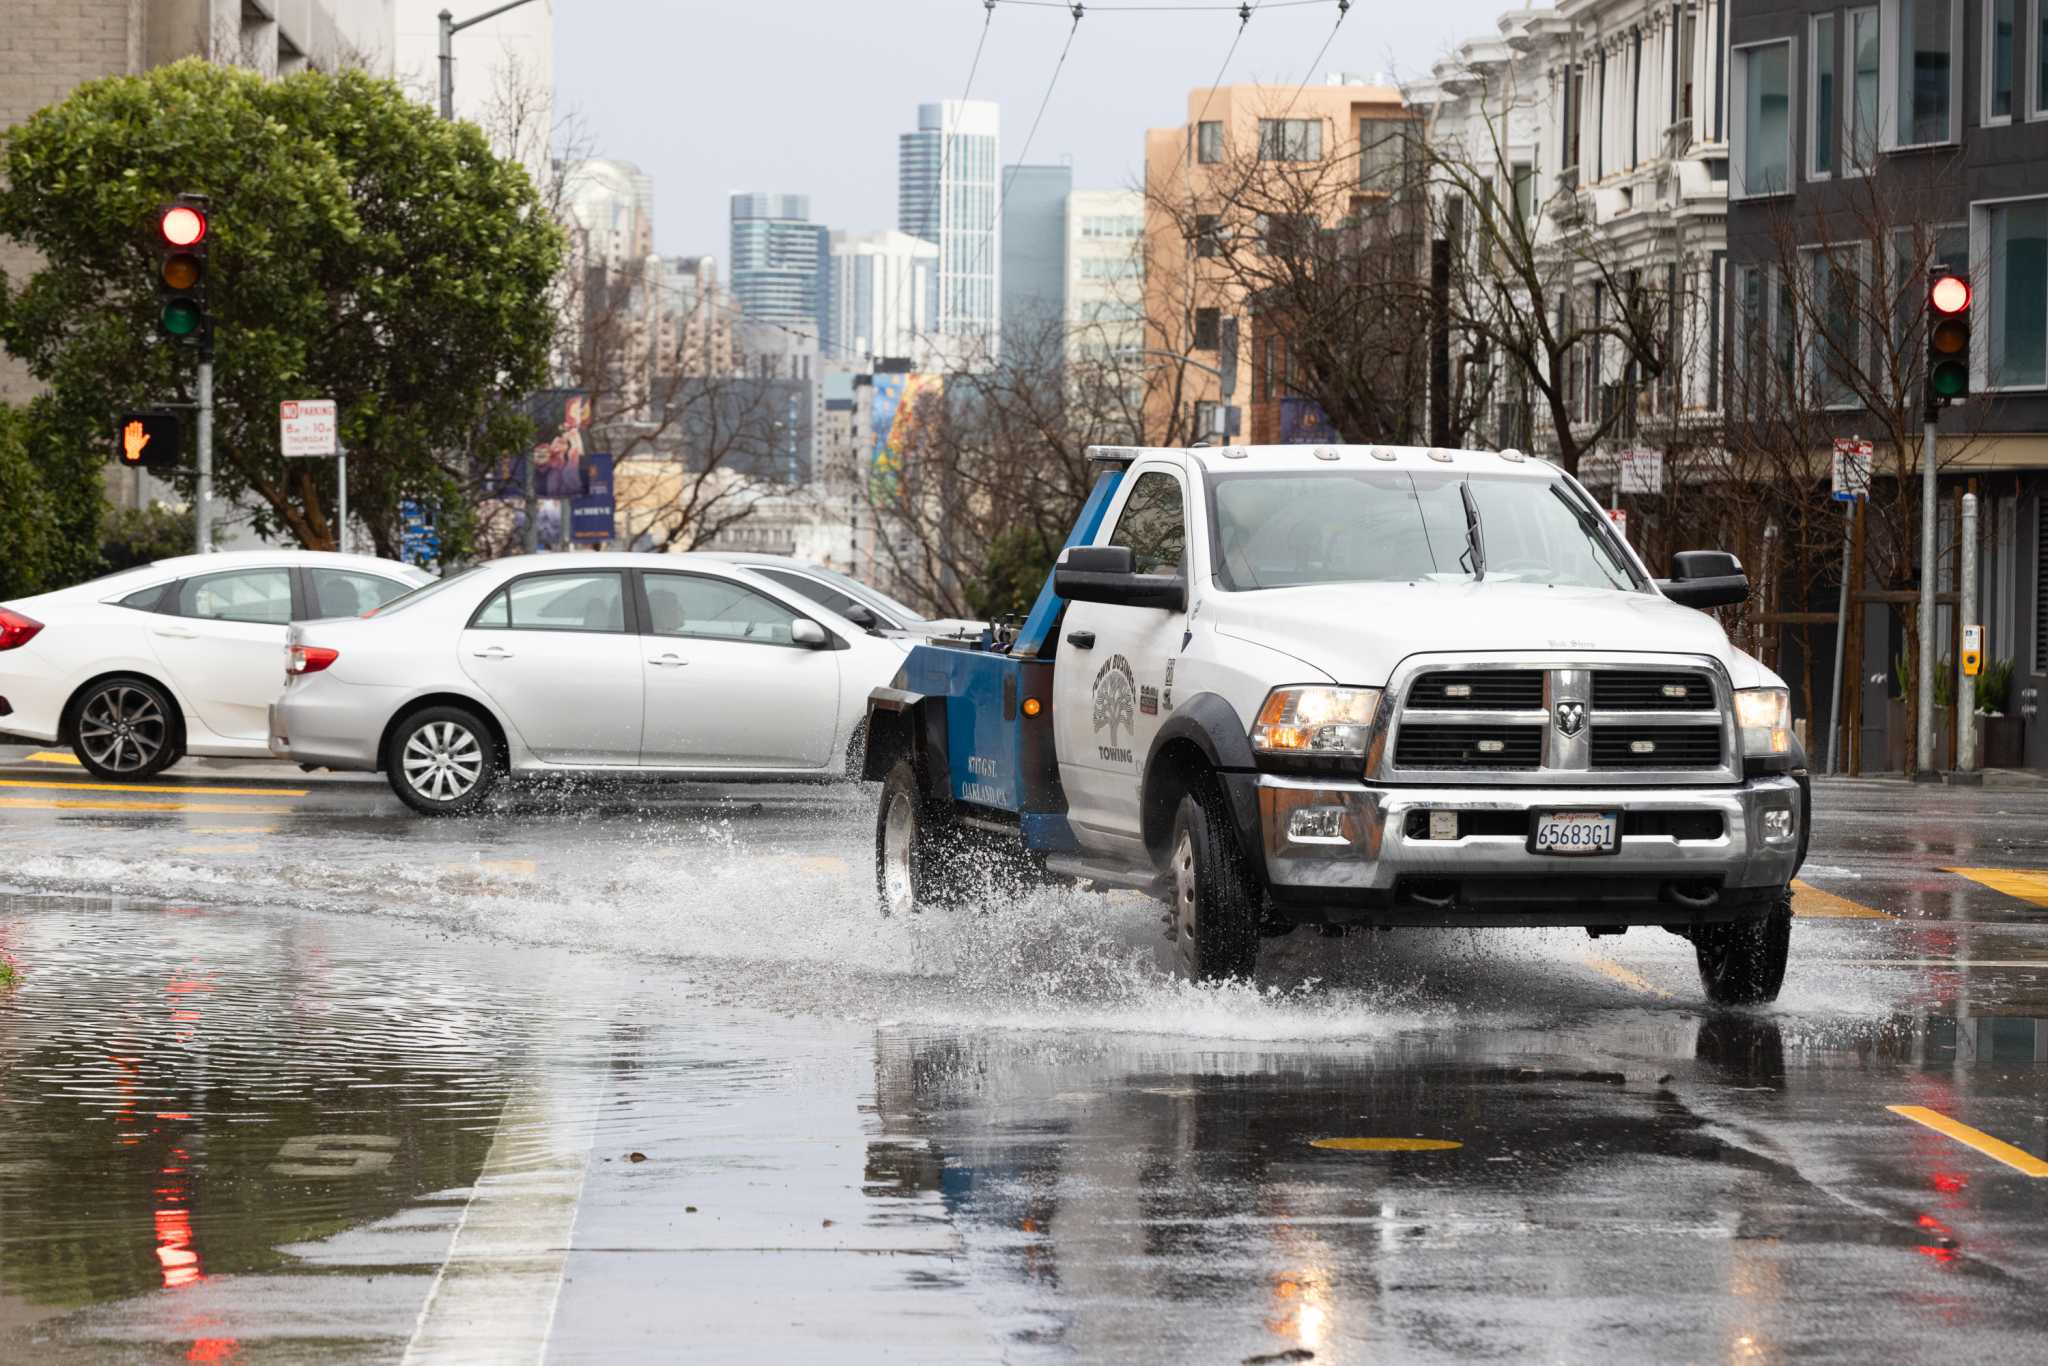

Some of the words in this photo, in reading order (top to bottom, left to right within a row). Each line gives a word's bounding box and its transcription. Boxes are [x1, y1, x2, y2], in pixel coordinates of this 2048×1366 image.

[299, 407, 336, 416] PARKING
[1098, 745, 1133, 763] TOWING
[1538, 824, 1612, 845] 65683G1
